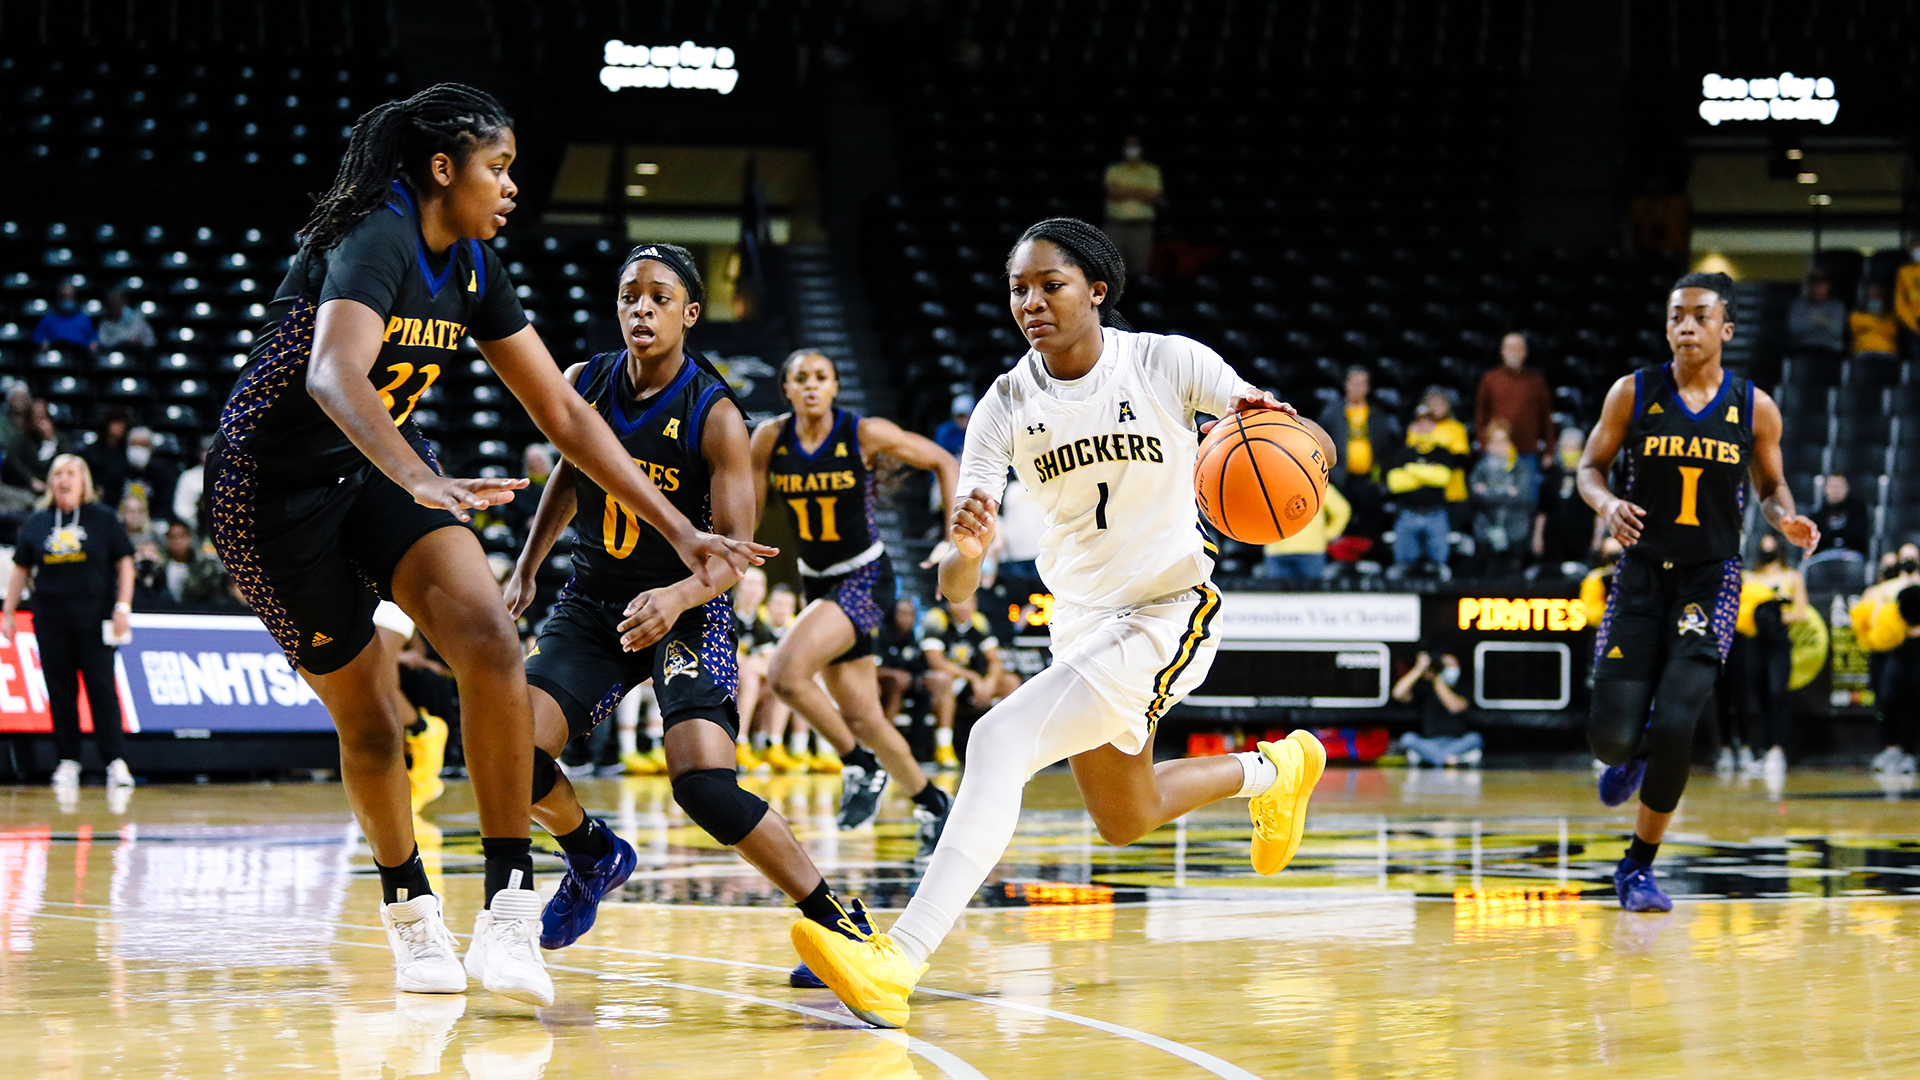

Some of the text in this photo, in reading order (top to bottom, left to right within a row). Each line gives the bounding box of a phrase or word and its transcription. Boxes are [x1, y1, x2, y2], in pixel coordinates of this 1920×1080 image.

[604, 39, 735, 68] See us for a
[599, 65, 739, 95] quote today
[1702, 71, 1835, 99] See us for a
[1699, 97, 1840, 126] quote today
[383, 315, 467, 350] PIRATE
[1033, 433, 1164, 484] SHOCKERS
[1643, 435, 1740, 465] PIRATES
[1095, 481, 1109, 530] 1
[1675, 466, 1704, 526] 1
[603, 493, 641, 560] 0
[787, 496, 841, 541] 11
[1458, 597, 1587, 631] PIRATES
